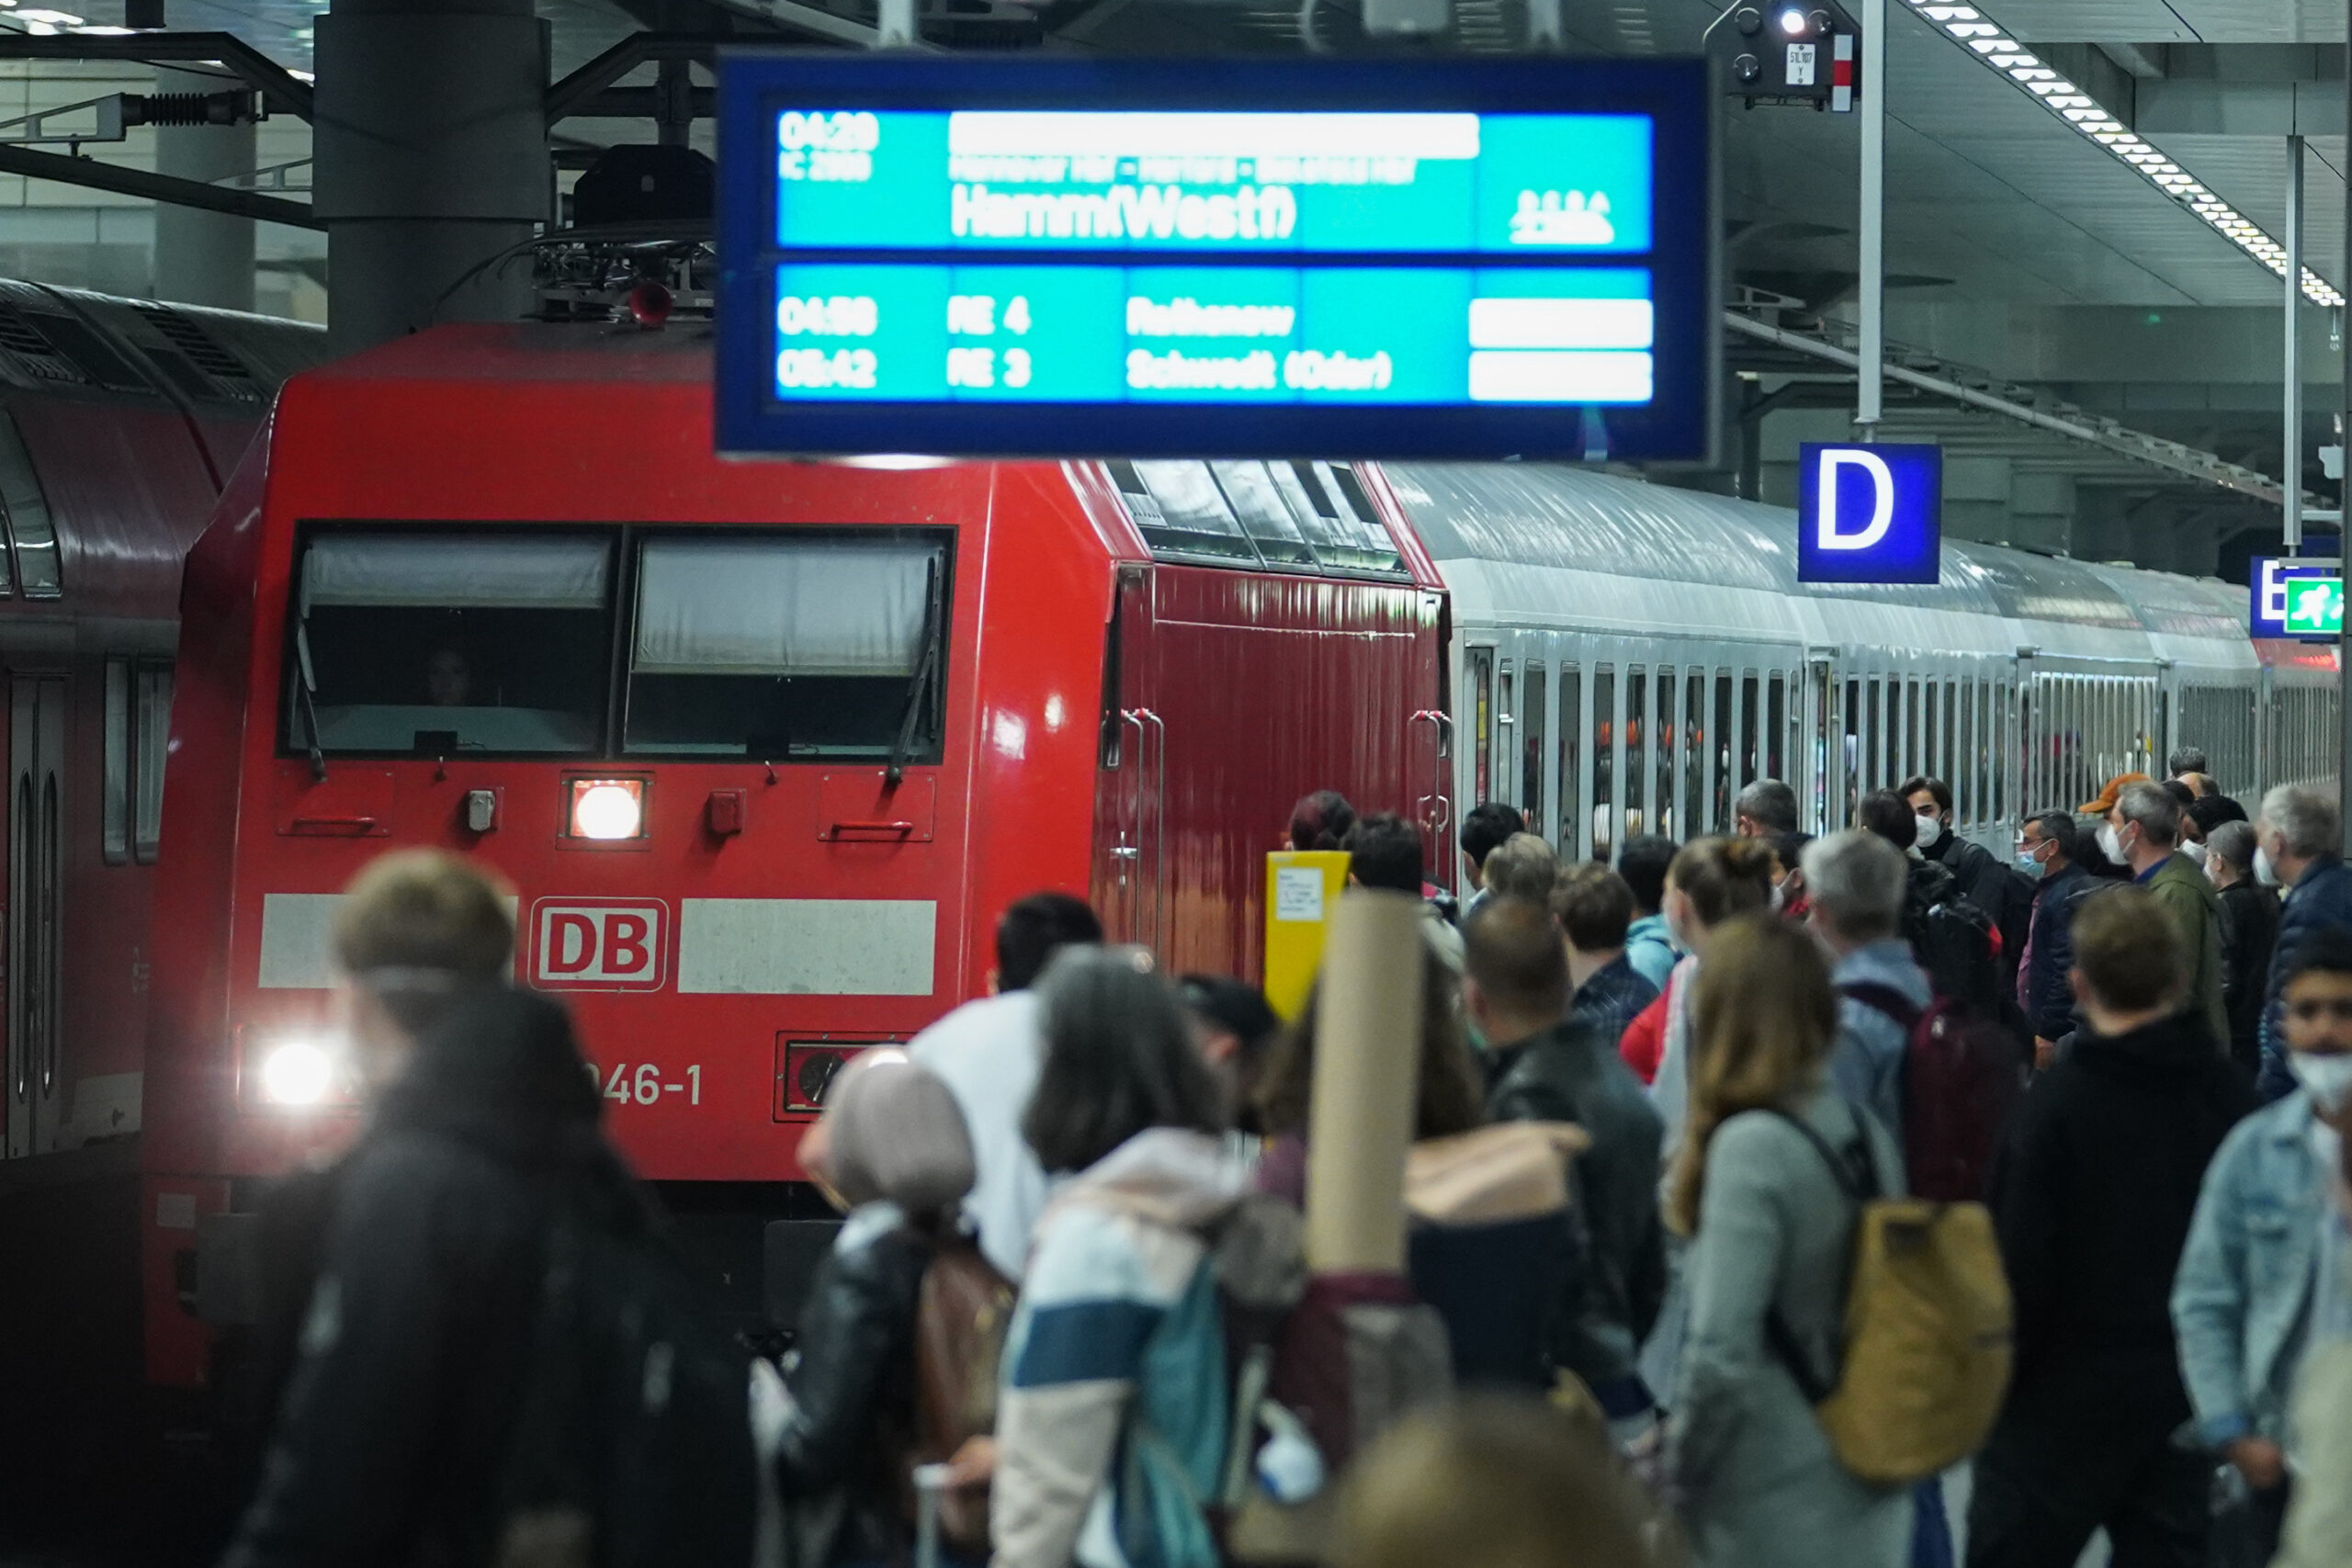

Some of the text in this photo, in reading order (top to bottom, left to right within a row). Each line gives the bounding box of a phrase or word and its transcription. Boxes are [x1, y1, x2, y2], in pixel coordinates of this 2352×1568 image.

[1798, 66, 1804, 76] Y
[1004, 297, 1031, 334] 4
[1004, 348, 1031, 387] 3
[1818, 449, 1894, 549] D
[2261, 560, 2300, 620] E
[547, 912, 650, 975] DB
